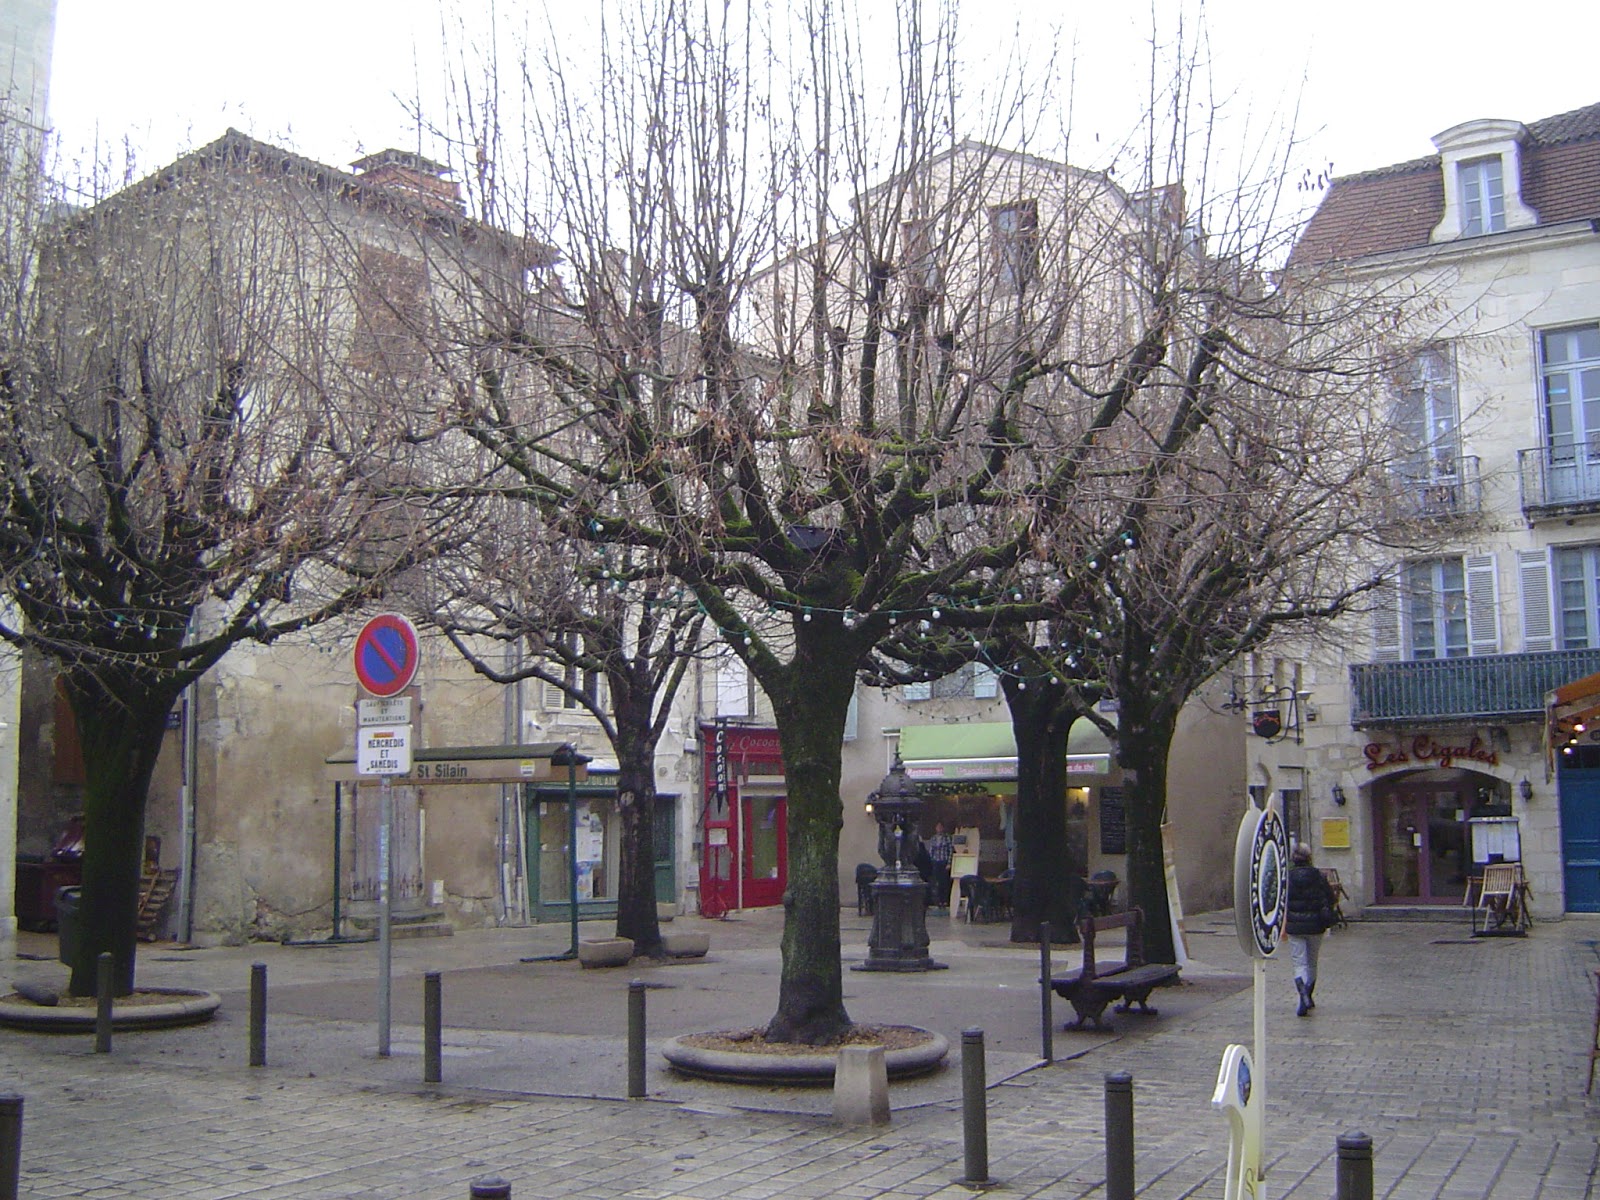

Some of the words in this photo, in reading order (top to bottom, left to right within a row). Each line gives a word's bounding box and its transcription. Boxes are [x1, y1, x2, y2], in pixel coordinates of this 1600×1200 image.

[368, 738, 404, 749] MERCREDIS
[380, 749, 389, 758] ET
[1364, 743, 1409, 770] Les
[1412, 735, 1499, 767] Cigales
[370, 760, 398, 769] SAMEDIS
[417, 764, 429, 778] St
[435, 763, 468, 777] Silain
